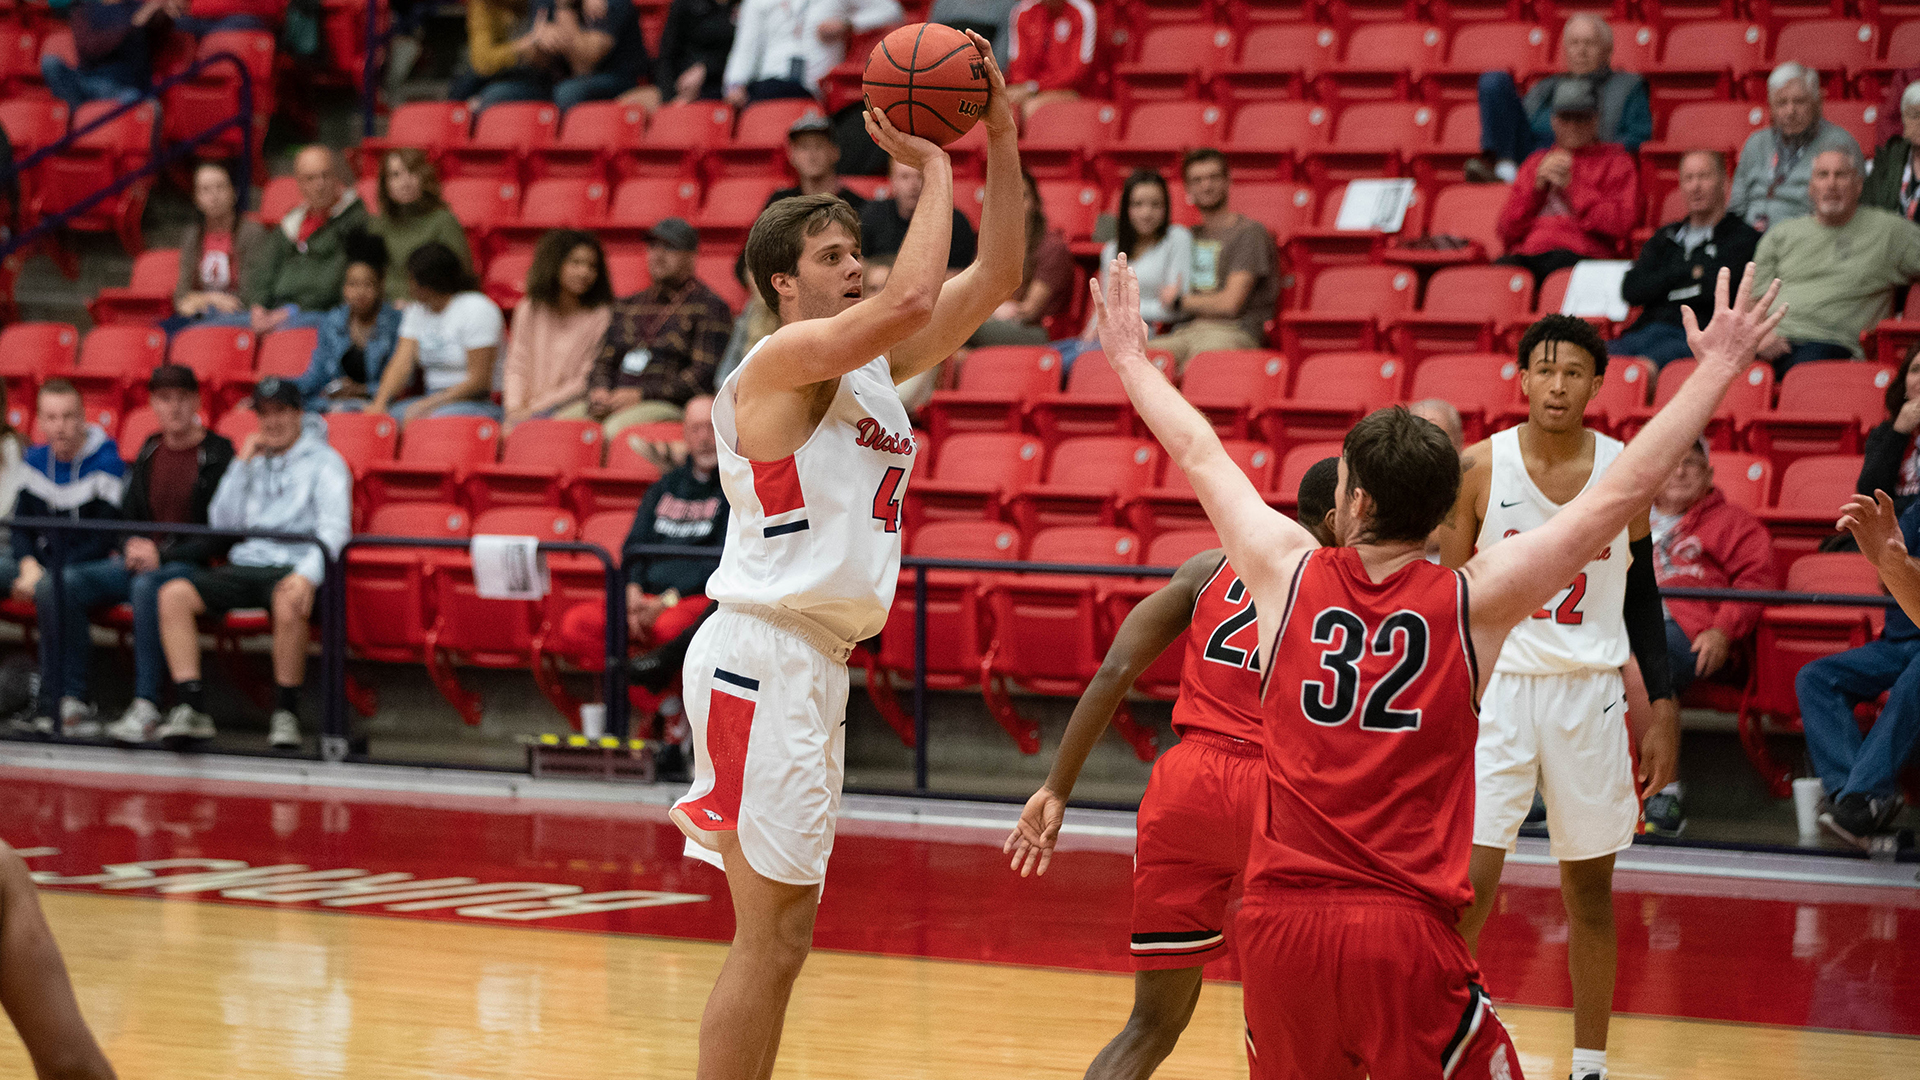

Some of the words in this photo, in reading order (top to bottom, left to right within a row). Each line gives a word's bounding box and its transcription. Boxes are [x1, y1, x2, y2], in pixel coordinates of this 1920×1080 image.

[855, 417, 912, 455] Dixie
[872, 466, 905, 533] 4
[1203, 576, 1261, 673] 2
[1531, 572, 1587, 625] 2
[1300, 606, 1430, 733] 32
